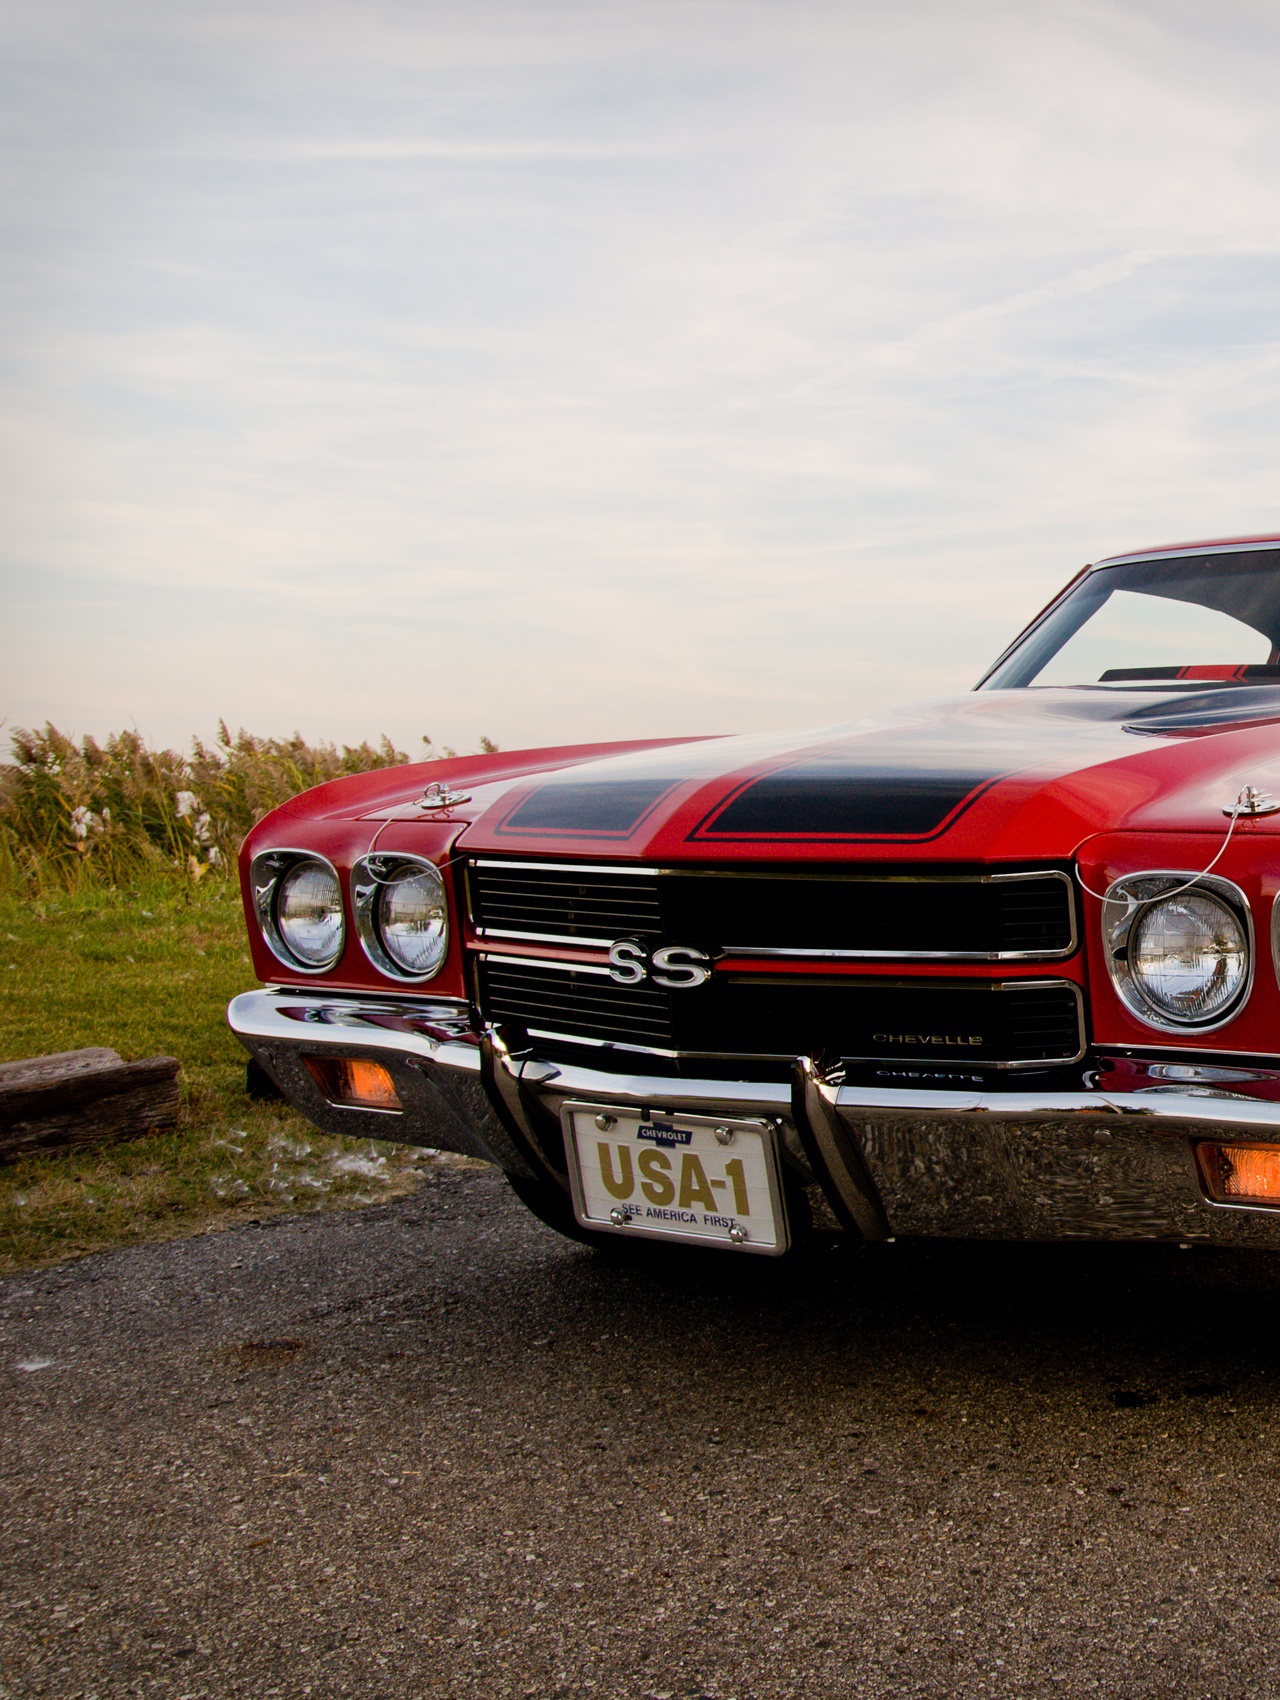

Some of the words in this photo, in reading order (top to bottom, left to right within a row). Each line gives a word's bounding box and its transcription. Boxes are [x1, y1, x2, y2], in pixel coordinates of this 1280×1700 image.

[609, 942, 711, 988] SS
[872, 1034, 983, 1046] CHEVELLE
[641, 1128, 687, 1142] CHEVROLET
[597, 1142, 750, 1216] USA-1
[621, 1202, 643, 1216] SEE
[646, 1207, 698, 1225] AMERICA
[703, 1213, 736, 1229] FIRST
